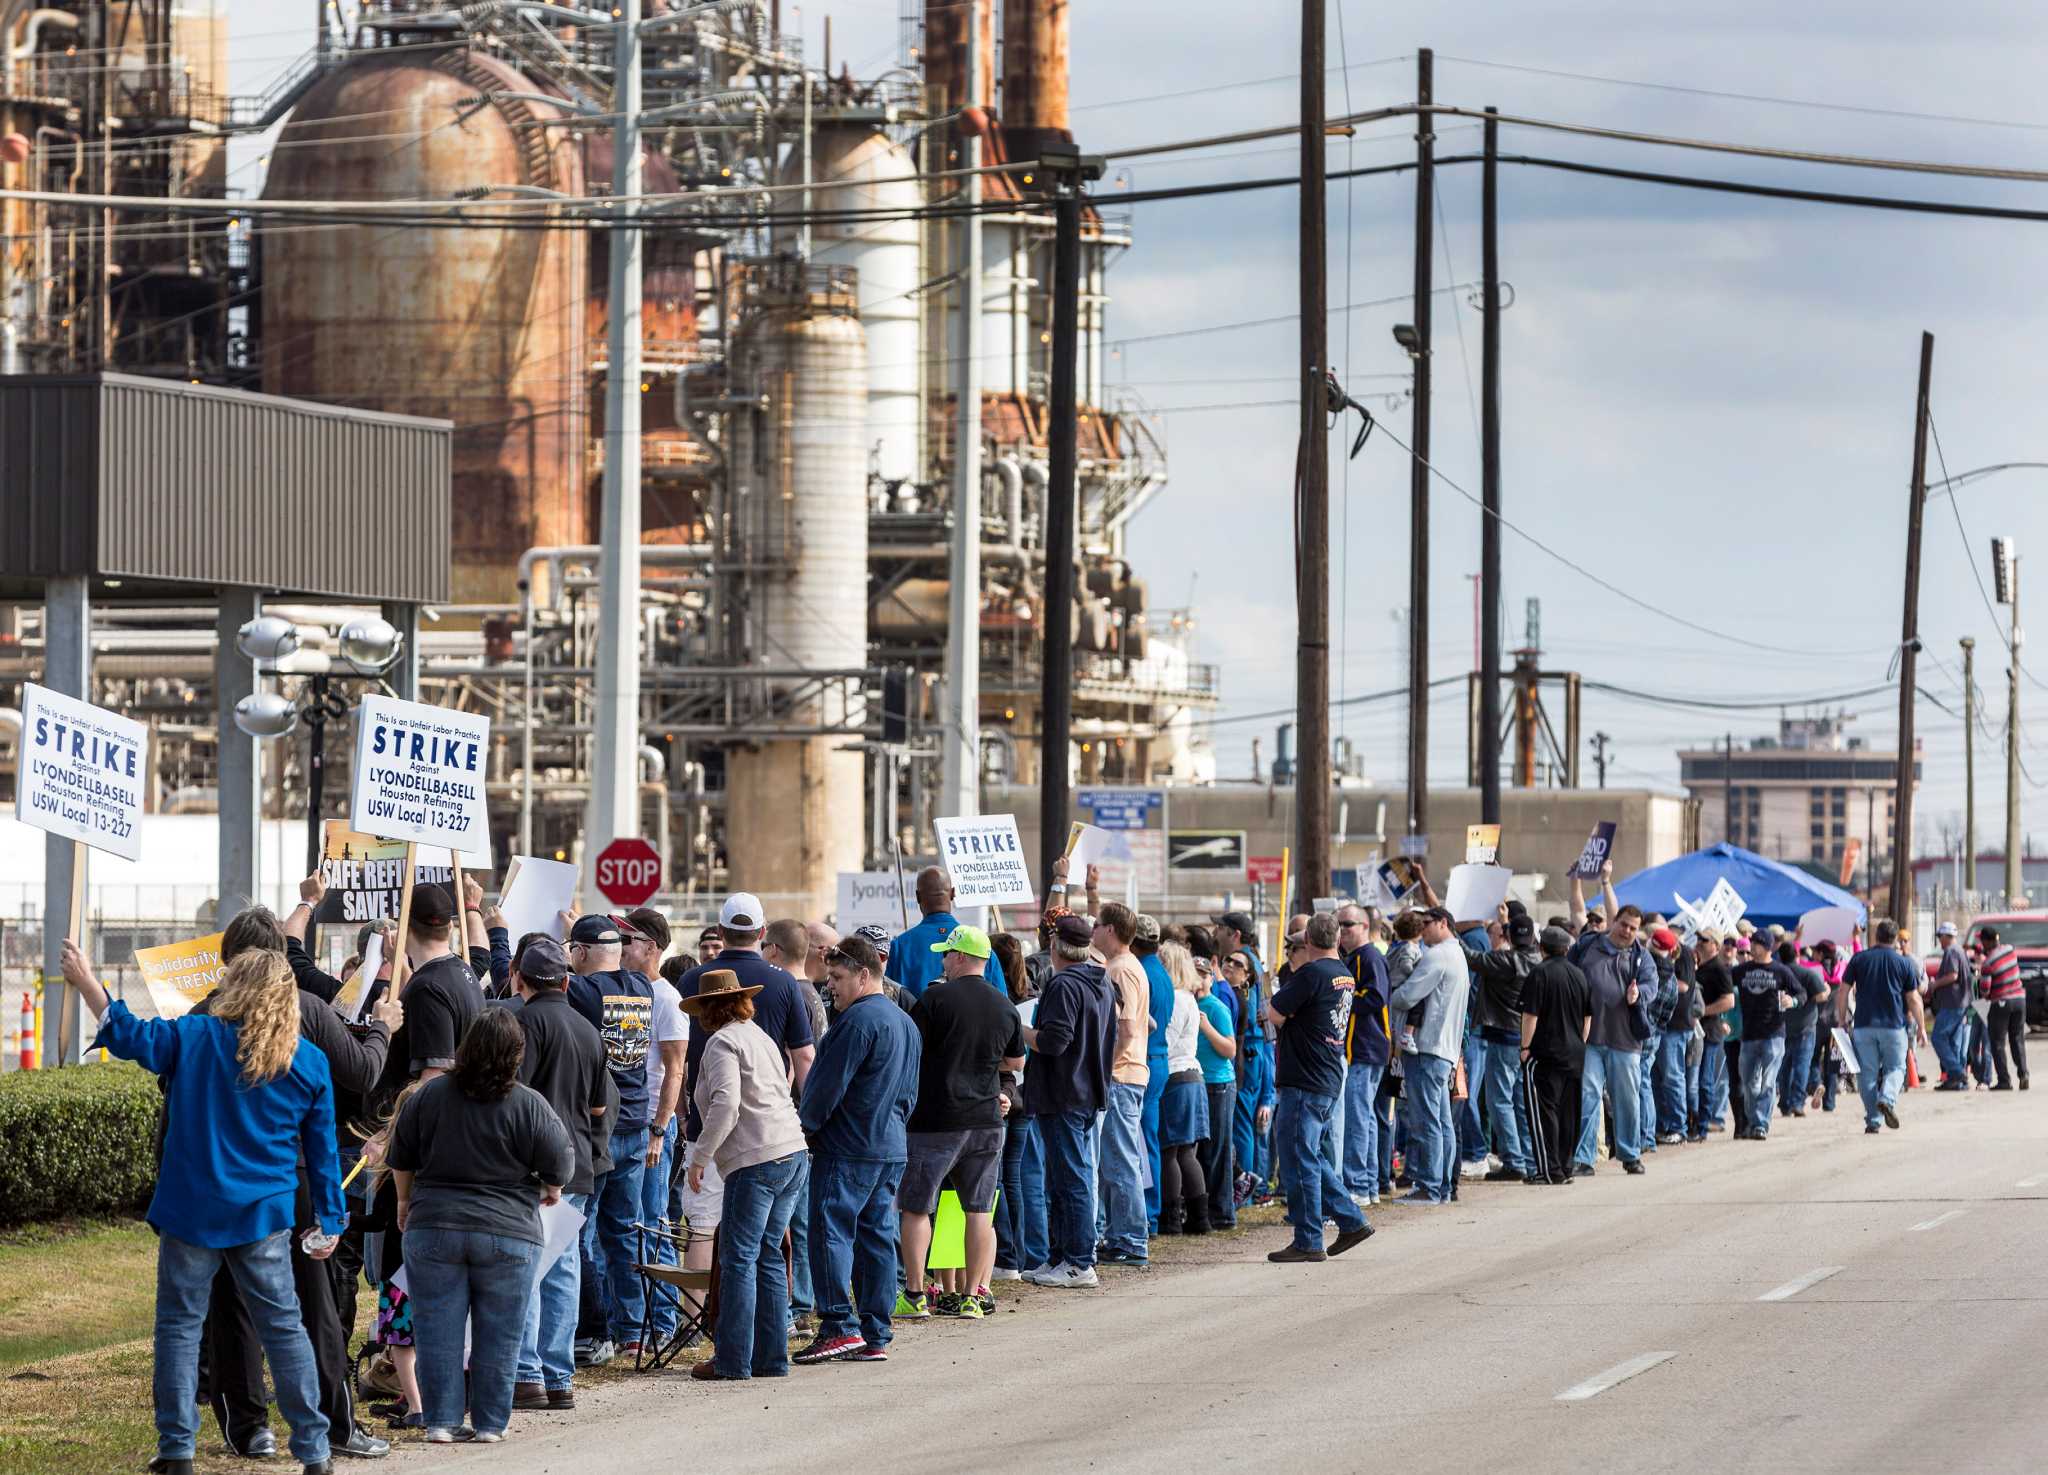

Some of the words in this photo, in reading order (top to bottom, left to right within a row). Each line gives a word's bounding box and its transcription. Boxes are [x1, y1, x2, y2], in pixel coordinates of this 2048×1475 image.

[37, 704, 50, 716] This
[70, 716, 91, 730] Unfair
[93, 723, 111, 738] Labor
[114, 731, 139, 747] Practice
[376, 713, 389, 723] This
[410, 720, 431, 730] Unfair
[433, 725, 452, 735] Labor
[455, 728, 480, 740] Practice
[35, 717, 136, 778] STRIKE
[373, 725, 478, 771] STRIKE
[72, 758, 100, 775] Against
[410, 762, 440, 774] Against
[33, 759, 136, 807] LYONDELLBASELL
[370, 768, 476, 800] LYONDELLBASELL
[32, 791, 59, 814] USW
[62, 802, 89, 825] Local
[94, 812, 131, 838] 13-227
[44, 780, 82, 802] Houston
[86, 794, 124, 819] Refining
[380, 785, 420, 803] Houston
[424, 793, 463, 814] Refining
[368, 799, 395, 818] USW
[398, 804, 426, 824] Local
[431, 811, 471, 832] 13-227
[948, 834, 1016, 855] STRIKE
[323, 858, 361, 889] SAFE
[600, 858, 658, 886] STOP
[953, 860, 1021, 874] LYONDELLBASELL
[963, 873, 989, 881] Houston
[990, 872, 1016, 880] Refining
[959, 884, 976, 895] USW
[978, 882, 996, 894] Local
[998, 881, 1023, 893] 13-227
[343, 890, 389, 921] SAVE
